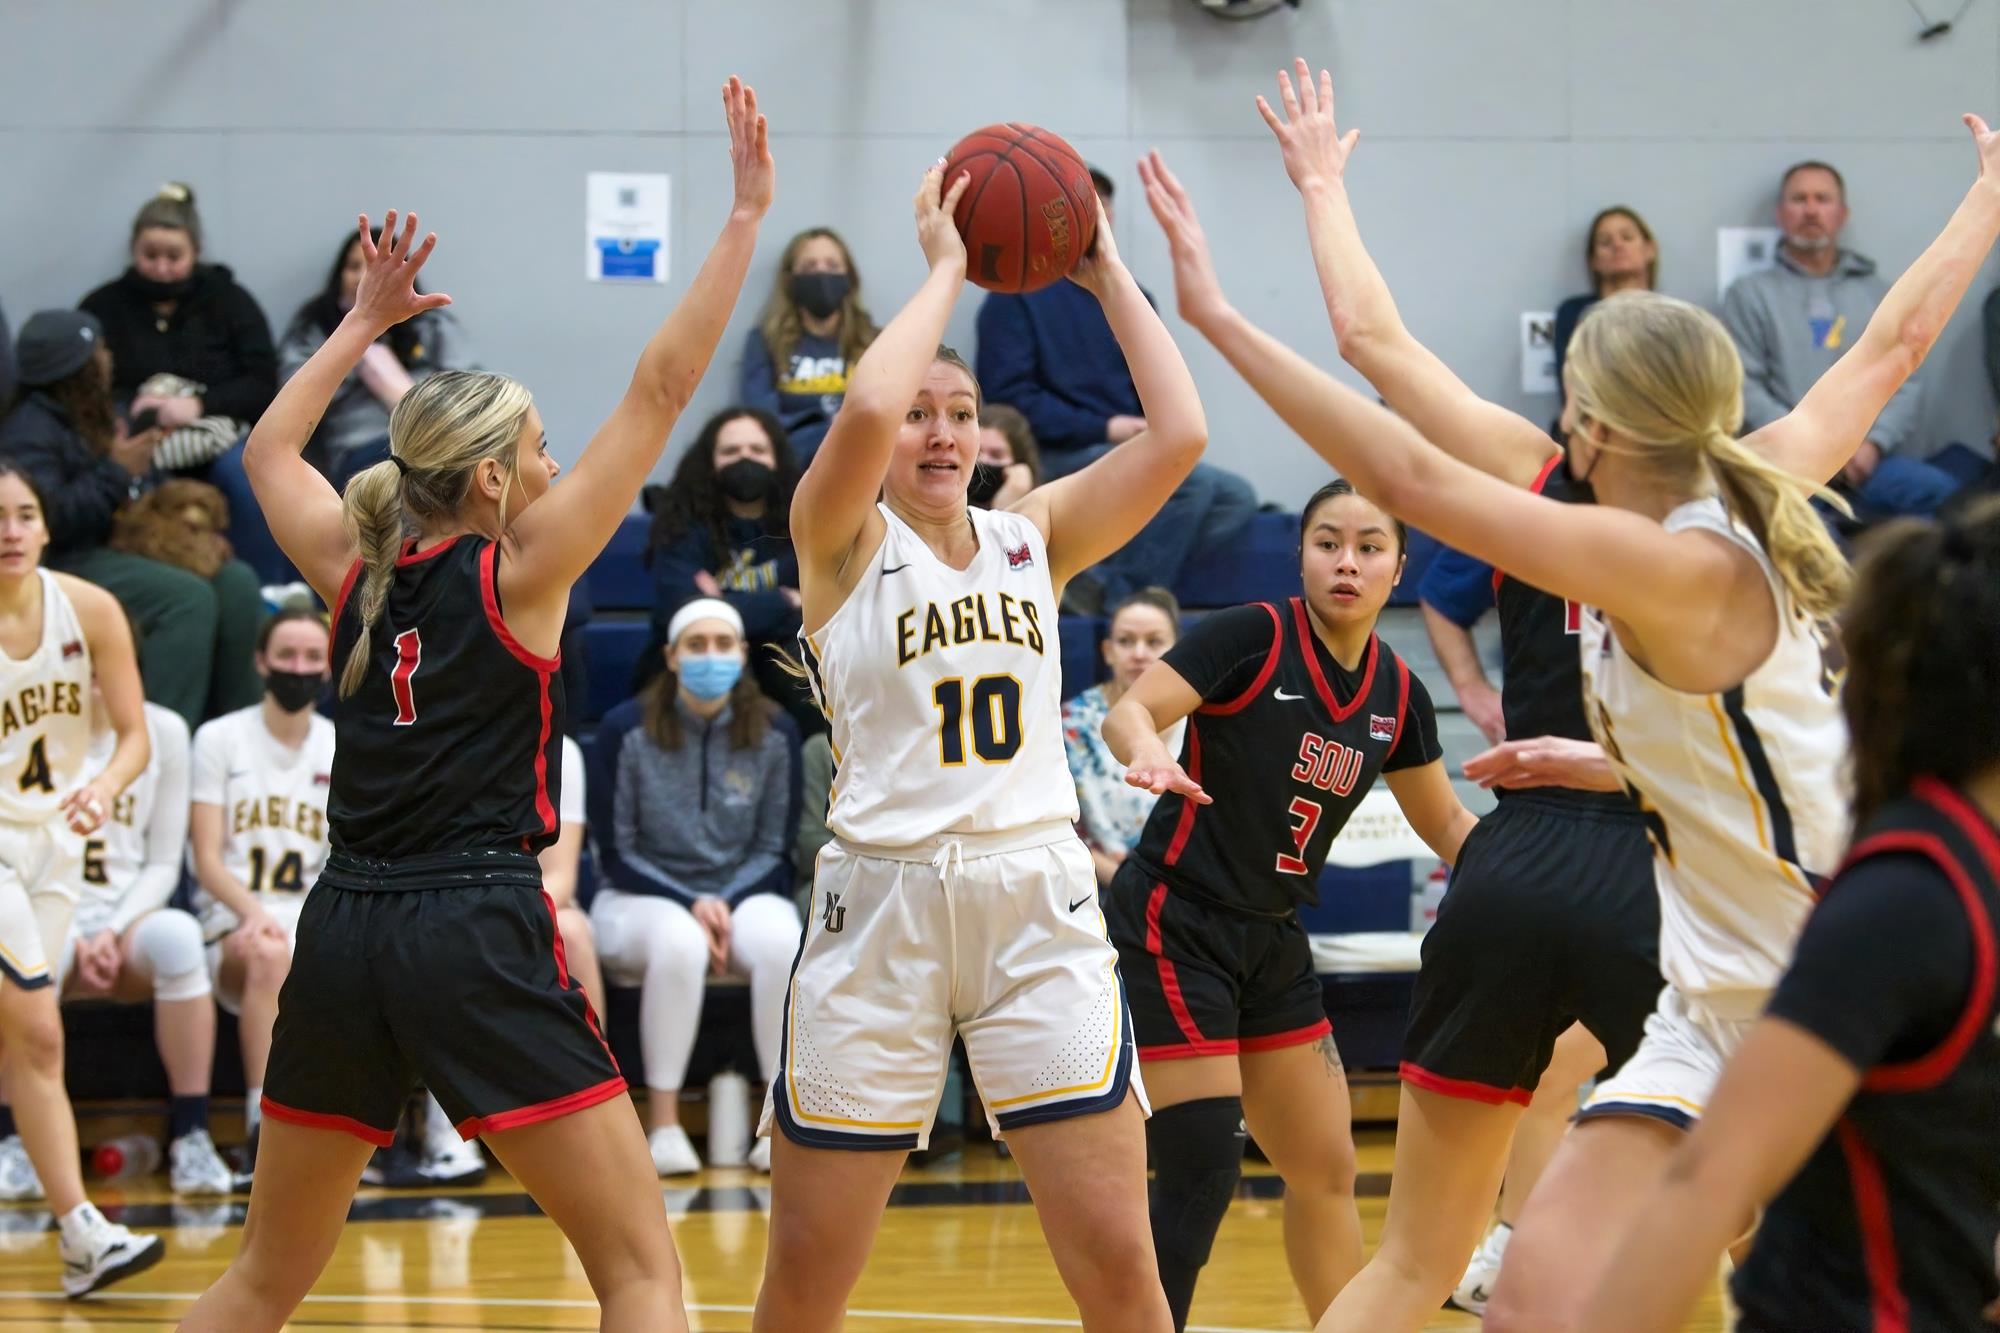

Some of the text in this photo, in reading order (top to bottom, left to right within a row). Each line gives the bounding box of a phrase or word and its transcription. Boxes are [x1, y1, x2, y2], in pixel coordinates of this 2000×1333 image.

[897, 592, 1045, 668] EAGLES
[390, 627, 422, 726] 1
[0, 681, 82, 740] AGLES
[932, 672, 1024, 768] 10
[18, 734, 55, 793] 4
[1291, 731, 1364, 797] SOU
[233, 795, 323, 843] EAGLES
[1276, 796, 1322, 876] 3
[247, 846, 304, 893] 14
